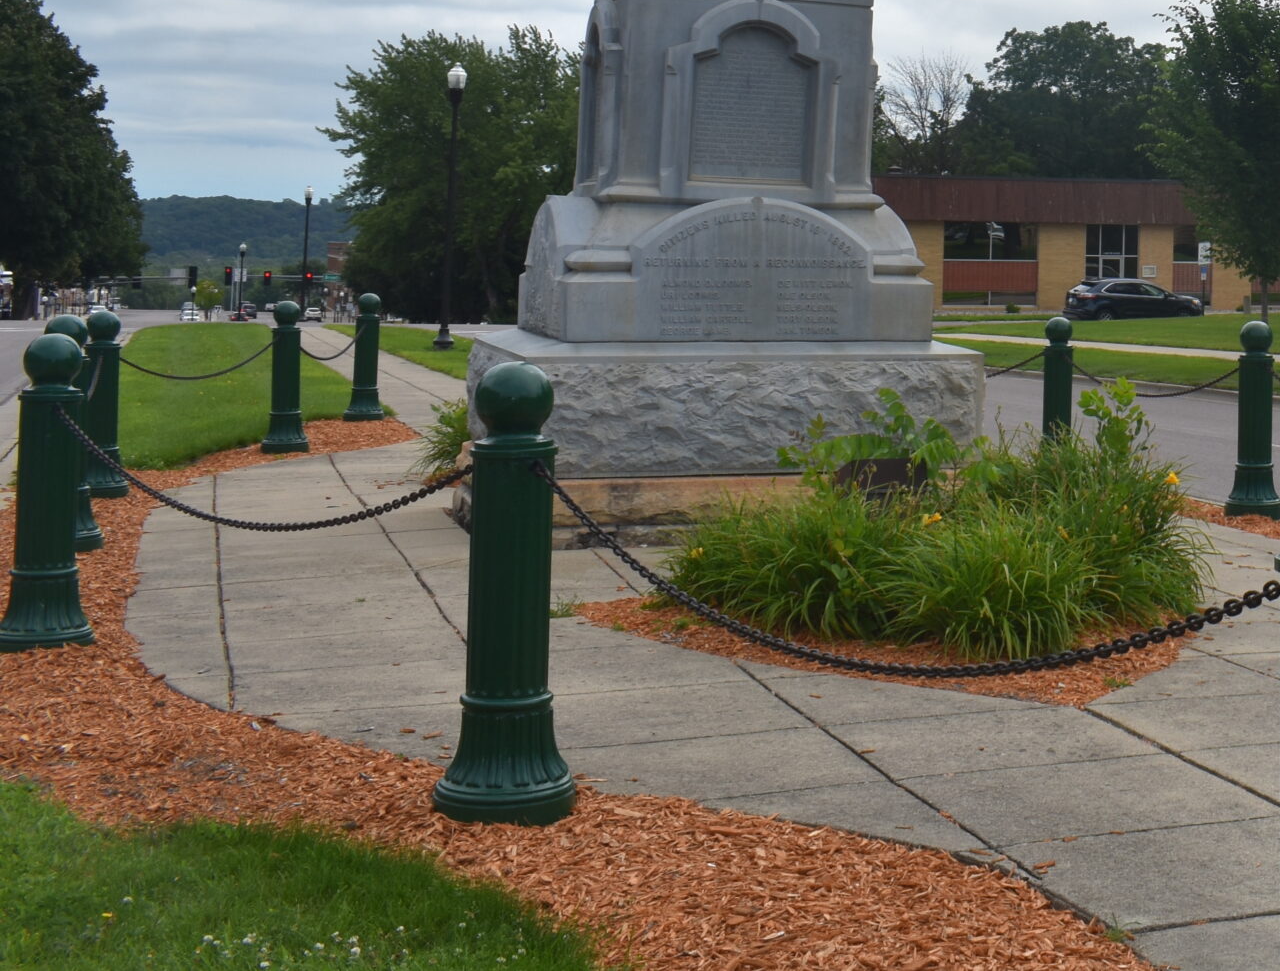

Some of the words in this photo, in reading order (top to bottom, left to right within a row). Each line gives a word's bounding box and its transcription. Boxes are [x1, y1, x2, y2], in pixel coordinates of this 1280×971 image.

[658, 220, 709, 253] CITIZENS
[714, 211, 757, 226] KILLED
[763, 212, 808, 229] AUGUST
[643, 257, 710, 269] RETURNING
[715, 257, 748, 269] FROM
[777, 290, 797, 301] OLE
[660, 302, 702, 312] WILLIAM
[660, 314, 702, 325] WILLIAM
[659, 325, 701, 336] GEORGE
